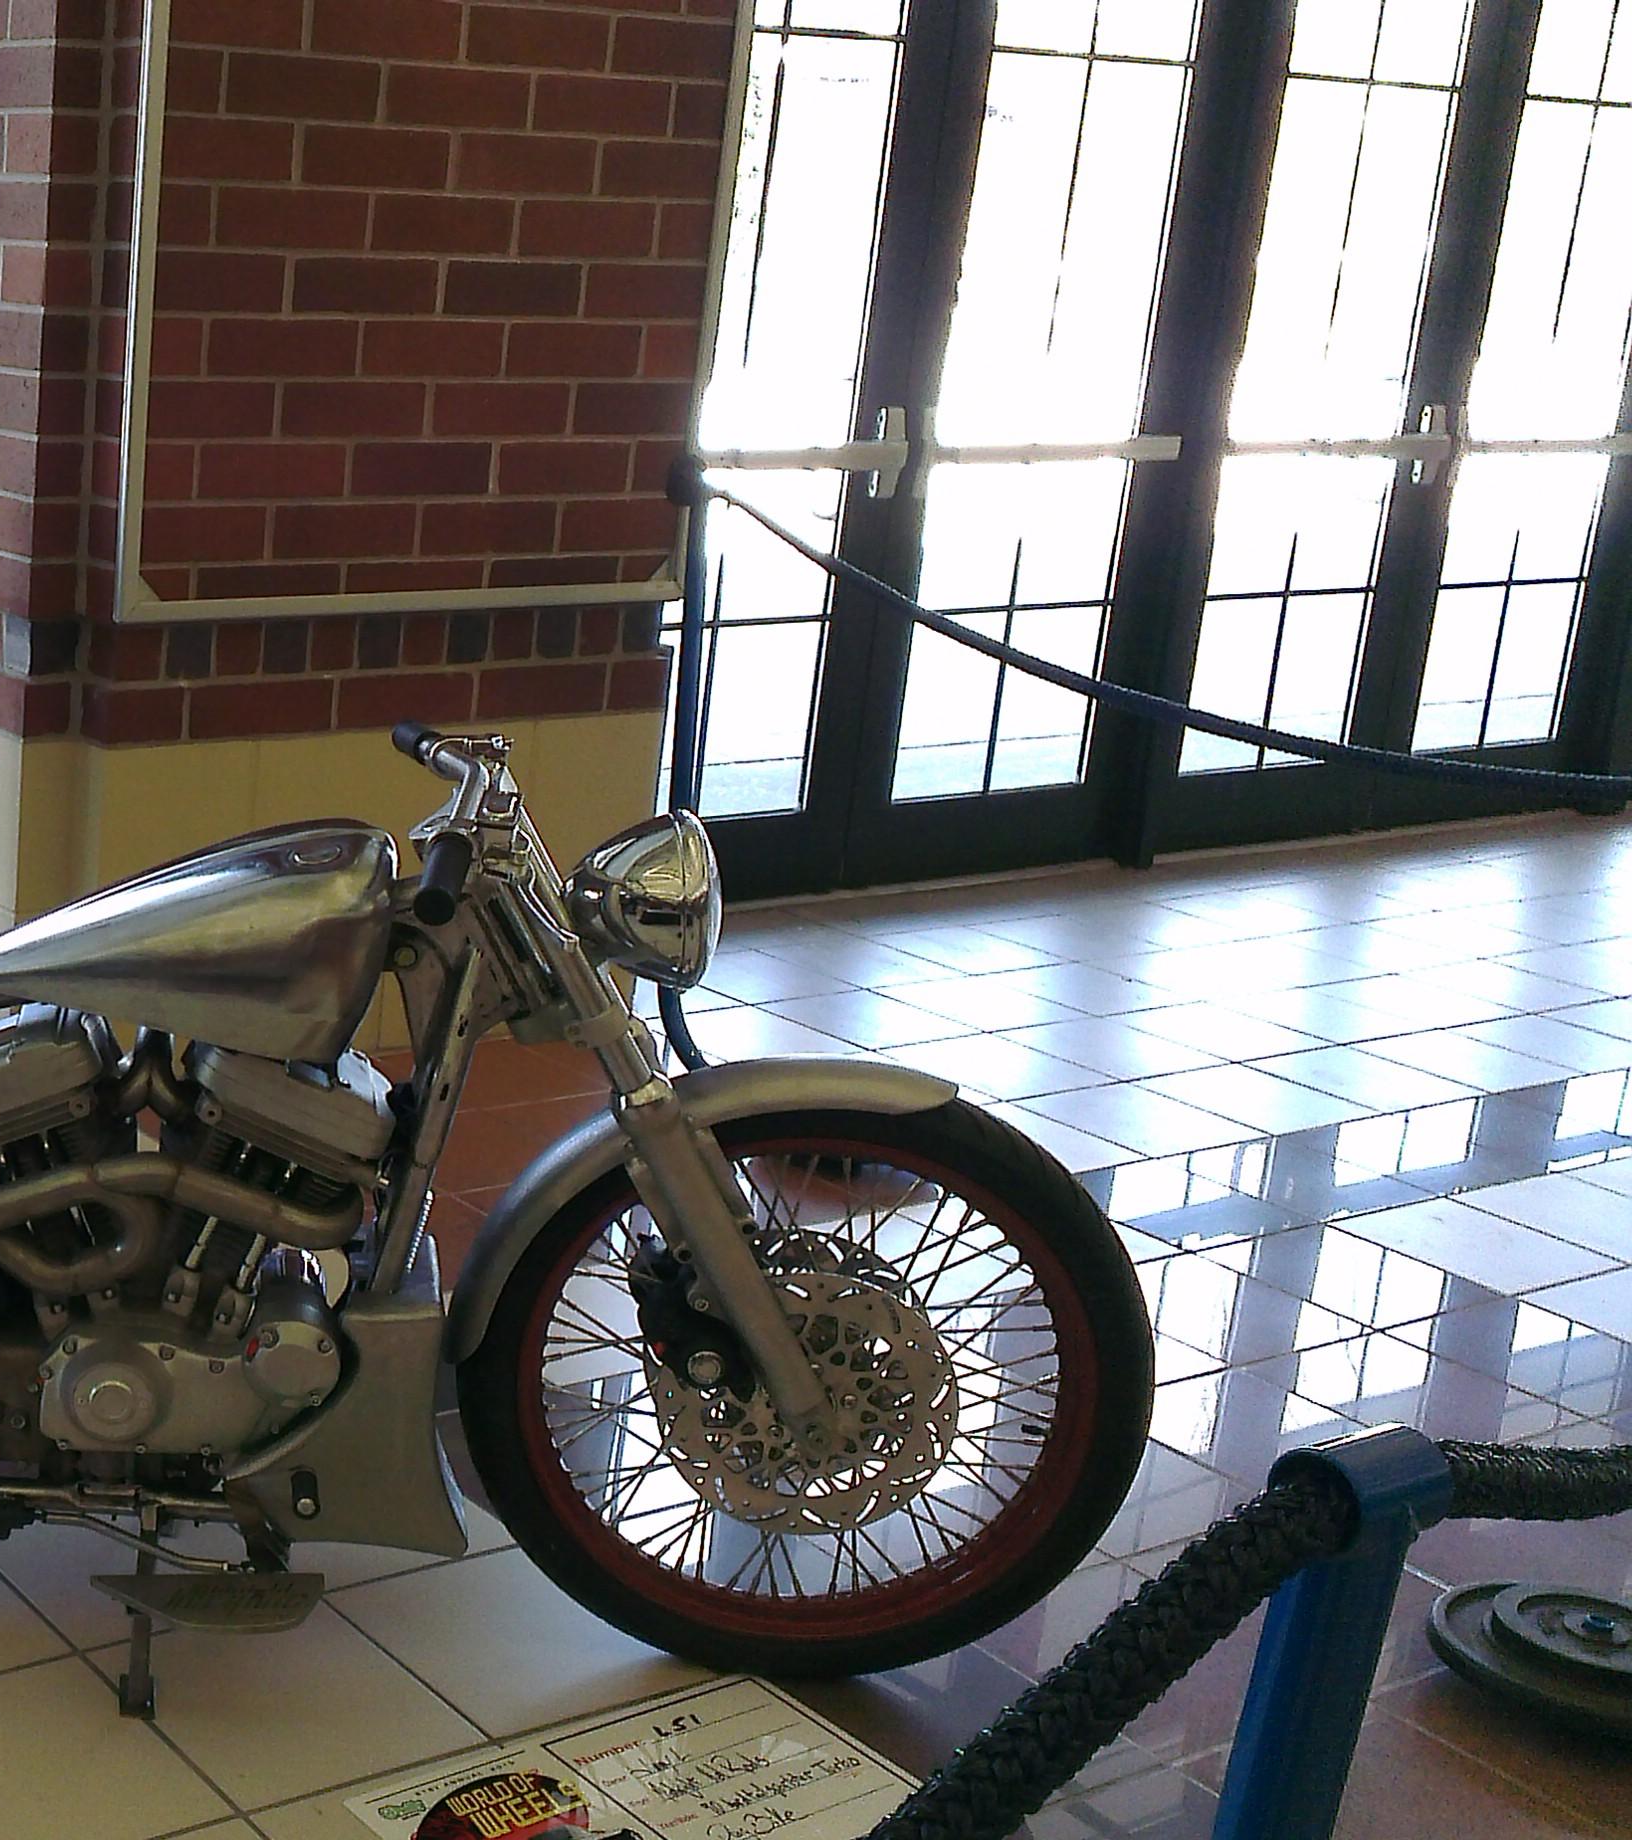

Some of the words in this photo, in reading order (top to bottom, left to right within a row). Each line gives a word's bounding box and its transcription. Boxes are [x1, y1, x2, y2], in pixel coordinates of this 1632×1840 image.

[445, 1780, 513, 1817] WORLD
[509, 1769, 544, 1796] OF
[468, 1777, 591, 1839] WHEELS
